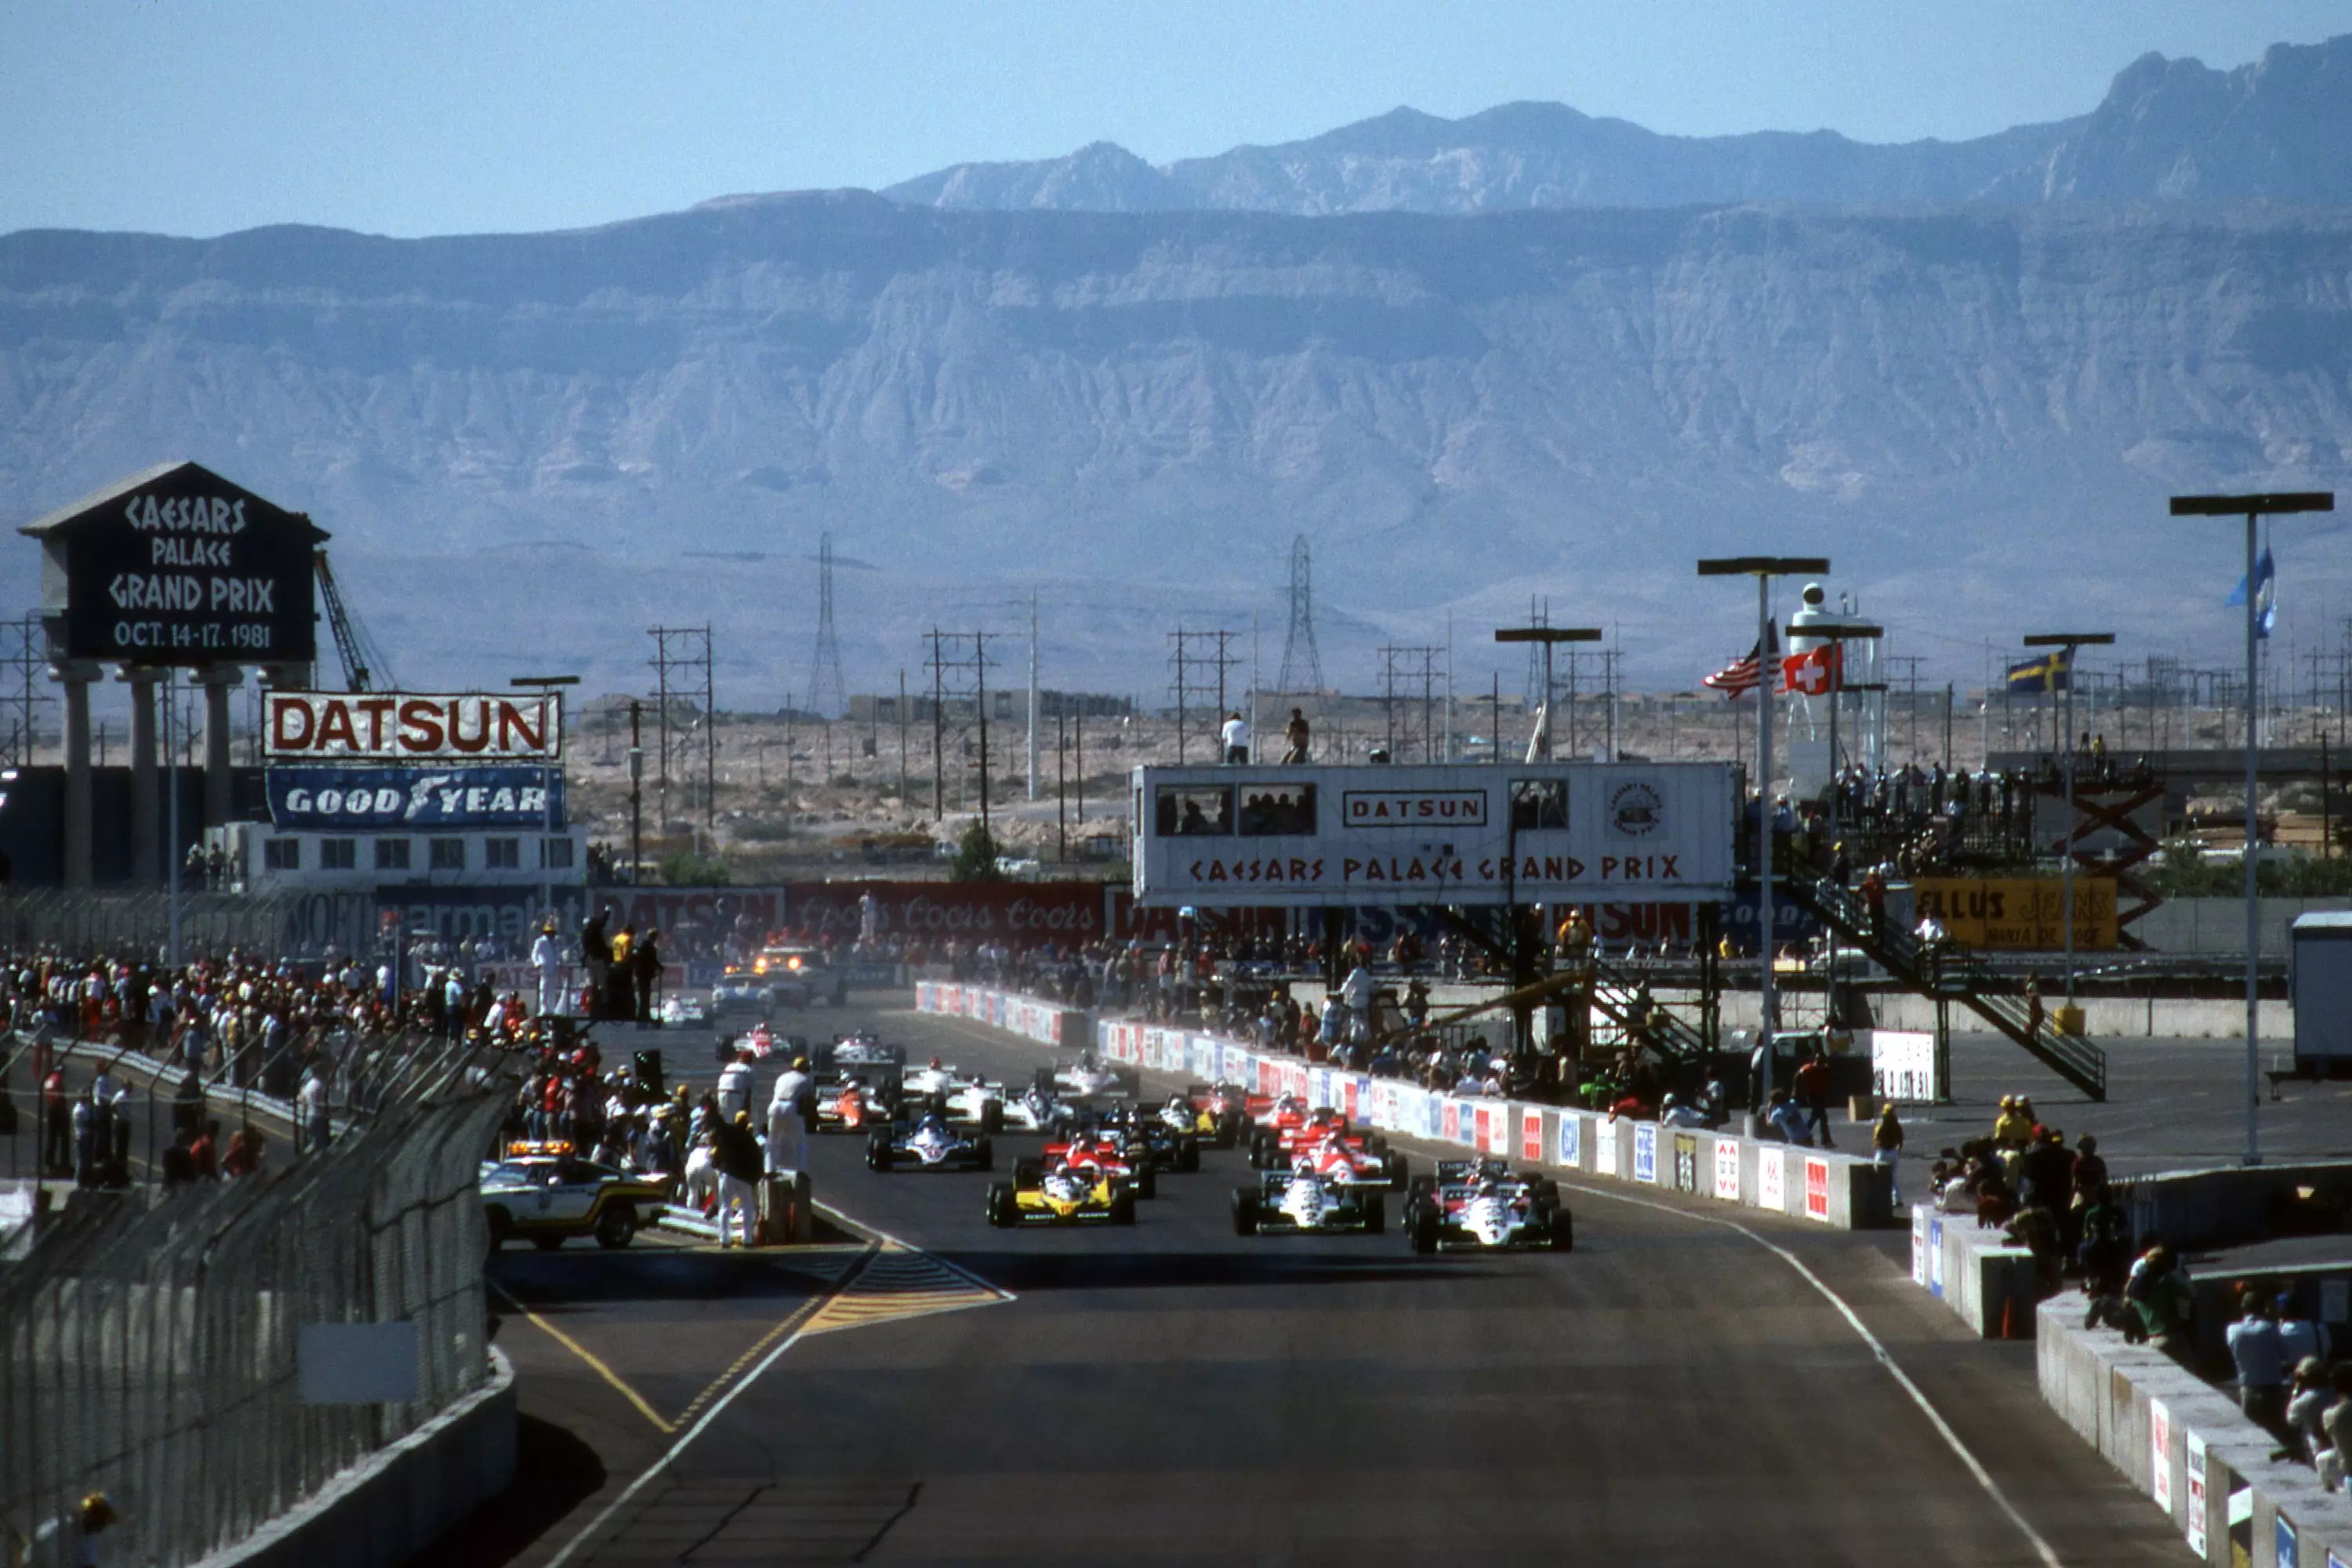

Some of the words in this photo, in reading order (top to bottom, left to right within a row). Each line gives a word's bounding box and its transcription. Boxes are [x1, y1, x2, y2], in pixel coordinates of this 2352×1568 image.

[125, 495, 246, 534] CAESARS
[152, 537, 231, 567] PALACE
[108, 574, 201, 611] GRAND
[211, 577, 274, 612] PRIX
[114, 622, 165, 647] OCT.
[231, 624, 270, 648] 1981
[272, 698, 546, 753] DATSUN
[1352, 800, 1479, 818] DATSUN
[1189, 857, 1324, 882] CAESARS
[1343, 856, 1462, 881] PALACE
[1478, 855, 1586, 880] GRAND
[1601, 854, 1680, 880] PRIX
[798, 895, 891, 931] Coos
[902, 895, 994, 931] Coors
[1007, 895, 1095, 931] Coors
[1915, 891, 2005, 920] ELLUS
[480, 966, 575, 989] DATSN
